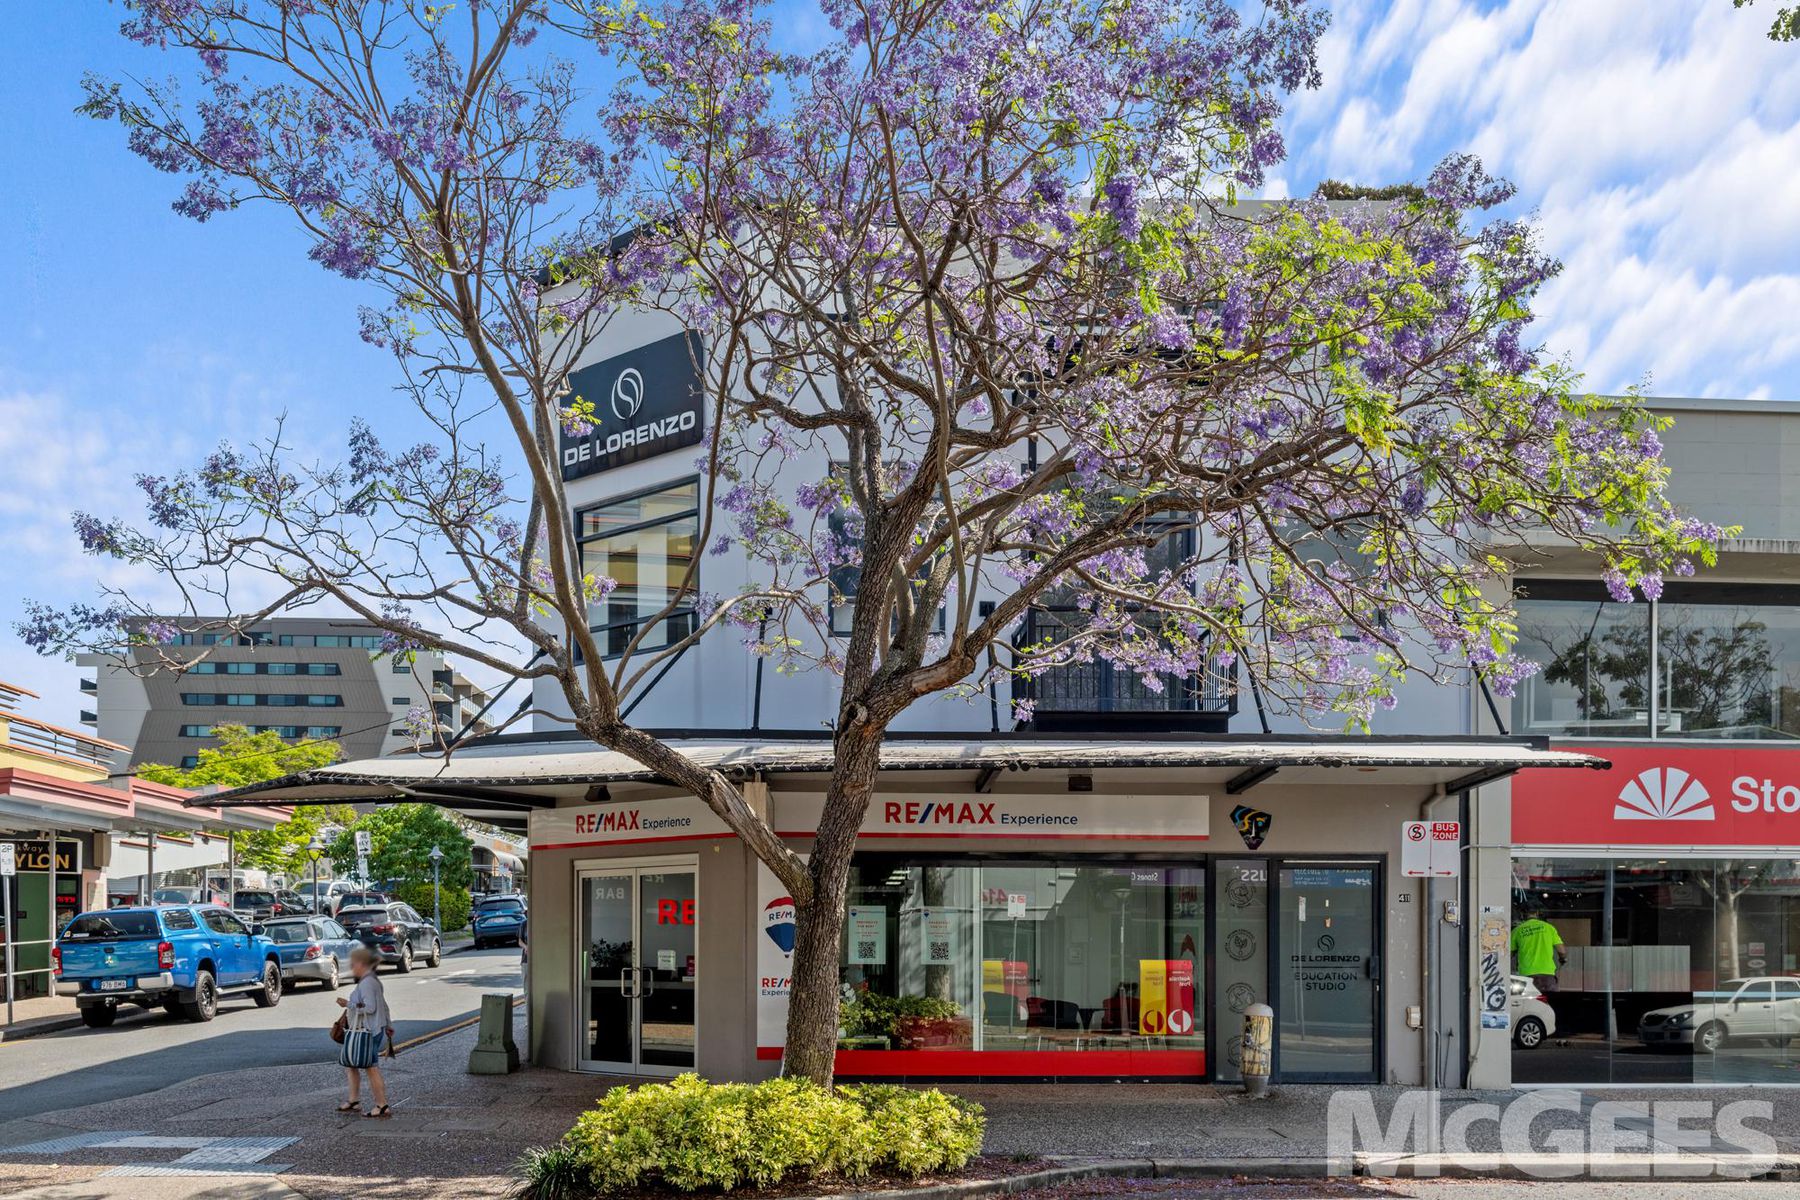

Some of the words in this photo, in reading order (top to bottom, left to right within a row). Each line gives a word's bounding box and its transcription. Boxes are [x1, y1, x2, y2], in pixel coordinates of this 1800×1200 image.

[564, 443, 590, 466] DE
[596, 411, 696, 457] LORENZO
[1731, 775, 1800, 813] Sto
[885, 802, 995, 824] RE/MAX
[1001, 813, 1078, 826] Experience
[575, 810, 640, 834] RE/MAX
[642, 817, 691, 830] Experience
[1436, 823, 1456, 831] BUS
[1433, 832, 1459, 840] ZONE
[1, 844, 12, 853] 2P
[1295, 972, 1358, 981] EDUCATION
[1305, 982, 1346, 991] STUDIO
